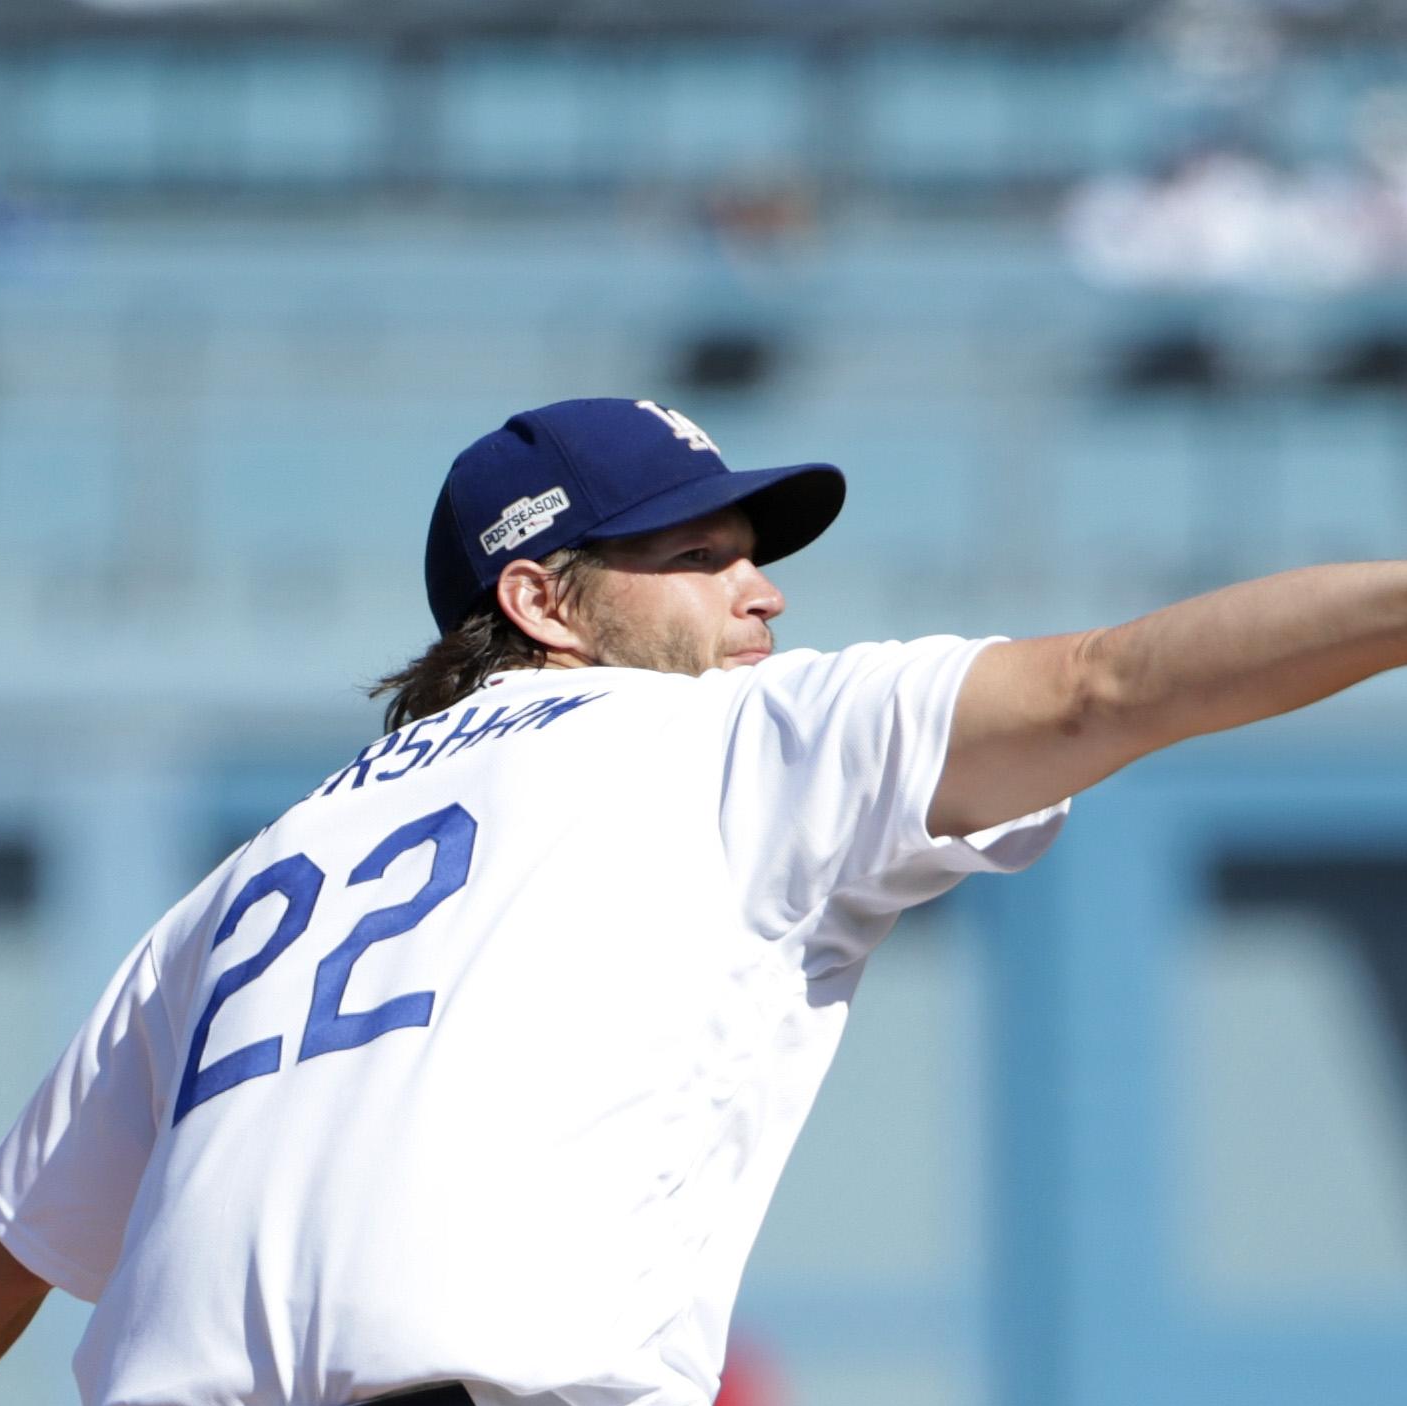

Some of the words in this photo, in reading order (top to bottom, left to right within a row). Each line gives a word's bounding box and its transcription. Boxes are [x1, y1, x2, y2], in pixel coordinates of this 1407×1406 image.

[482, 491, 564, 552] POSTSEASON
[295, 690, 613, 802] RSHAW
[171, 802, 479, 1130] 22
